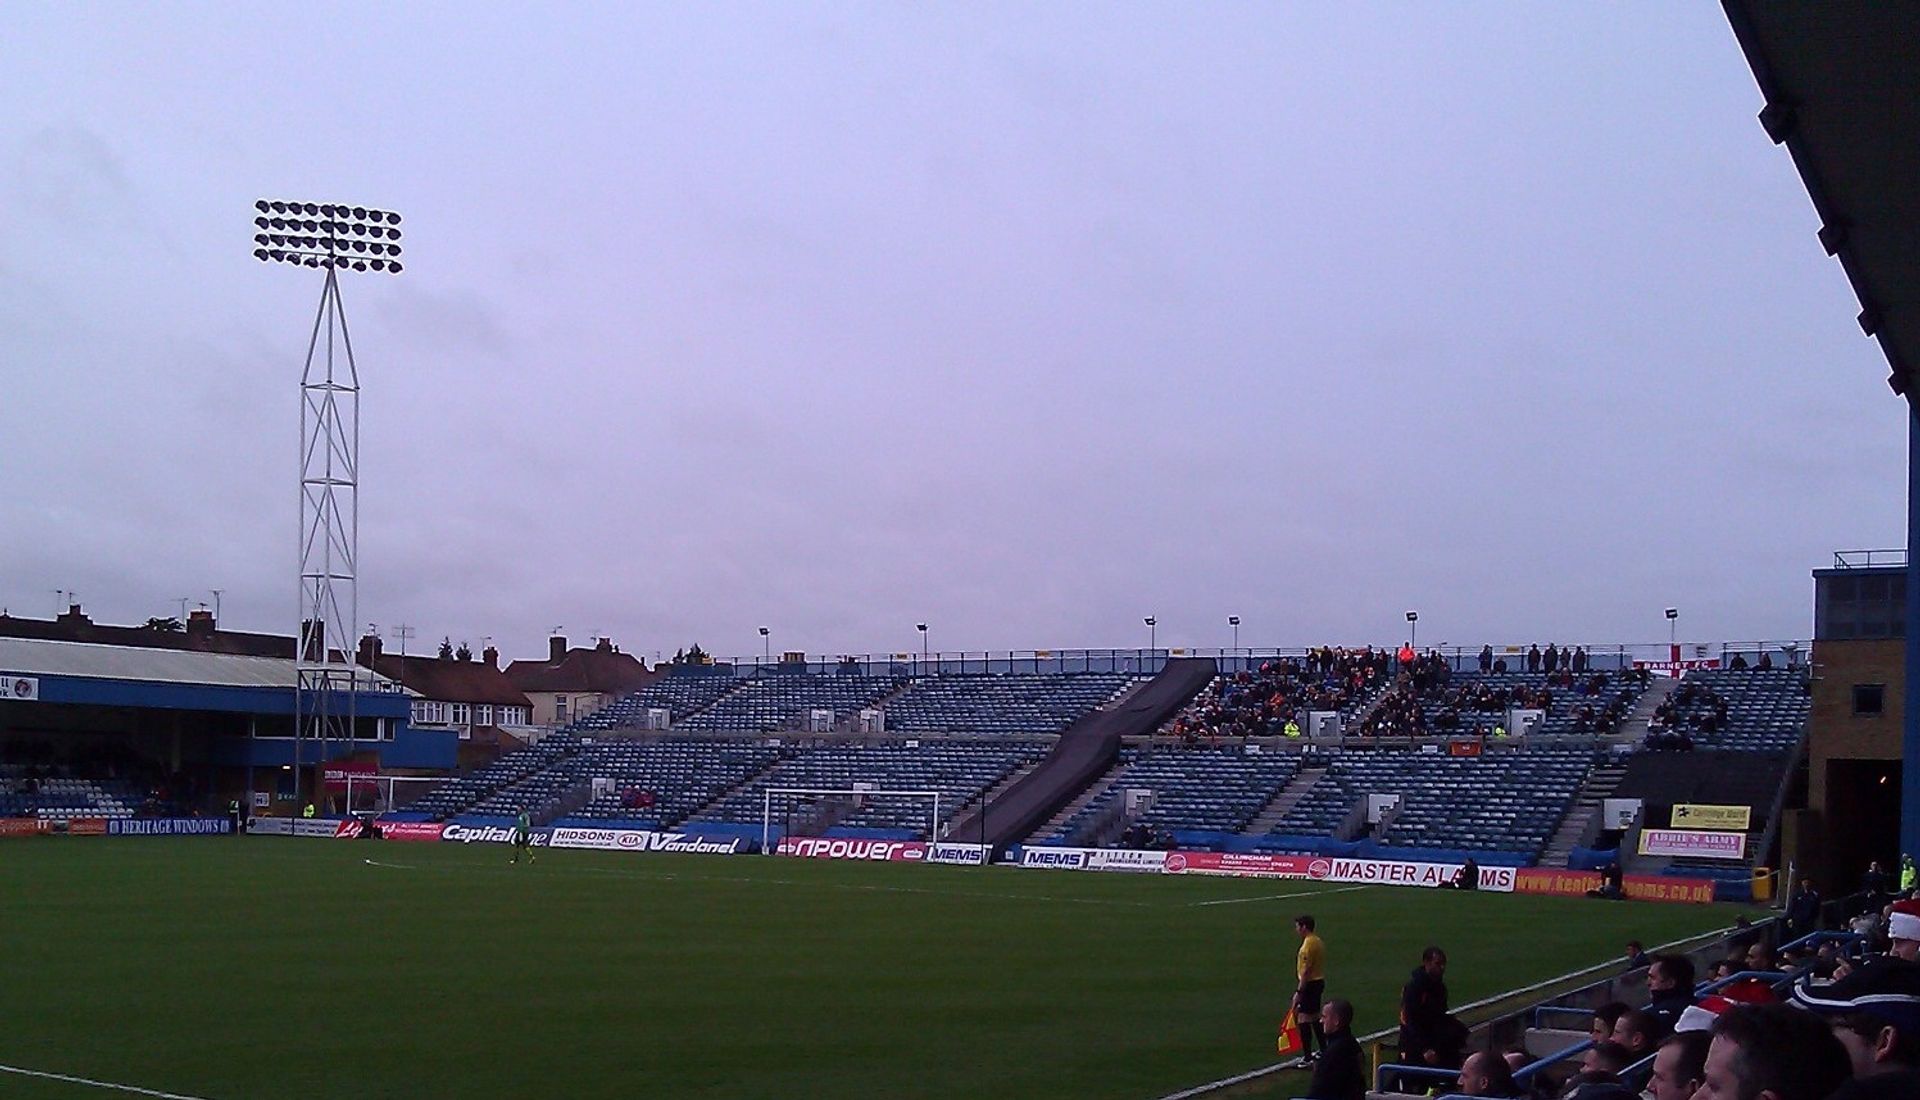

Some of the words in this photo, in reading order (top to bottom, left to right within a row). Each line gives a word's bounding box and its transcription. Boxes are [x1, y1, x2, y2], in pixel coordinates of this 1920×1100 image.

[1643, 661, 1689, 670] BARNET
[122, 819, 173, 834] HERITAGE
[173, 819, 219, 833] WINDOWS
[556, 830, 615, 842] HIDSONS
[621, 837, 639, 846] KIA
[650, 833, 738, 854] Vandanel
[932, 848, 981, 861] MEMS
[1028, 852, 1081, 866] MEMS
[1334, 861, 1417, 882] MASTER
[1423, 866, 1511, 887] ALAMS
